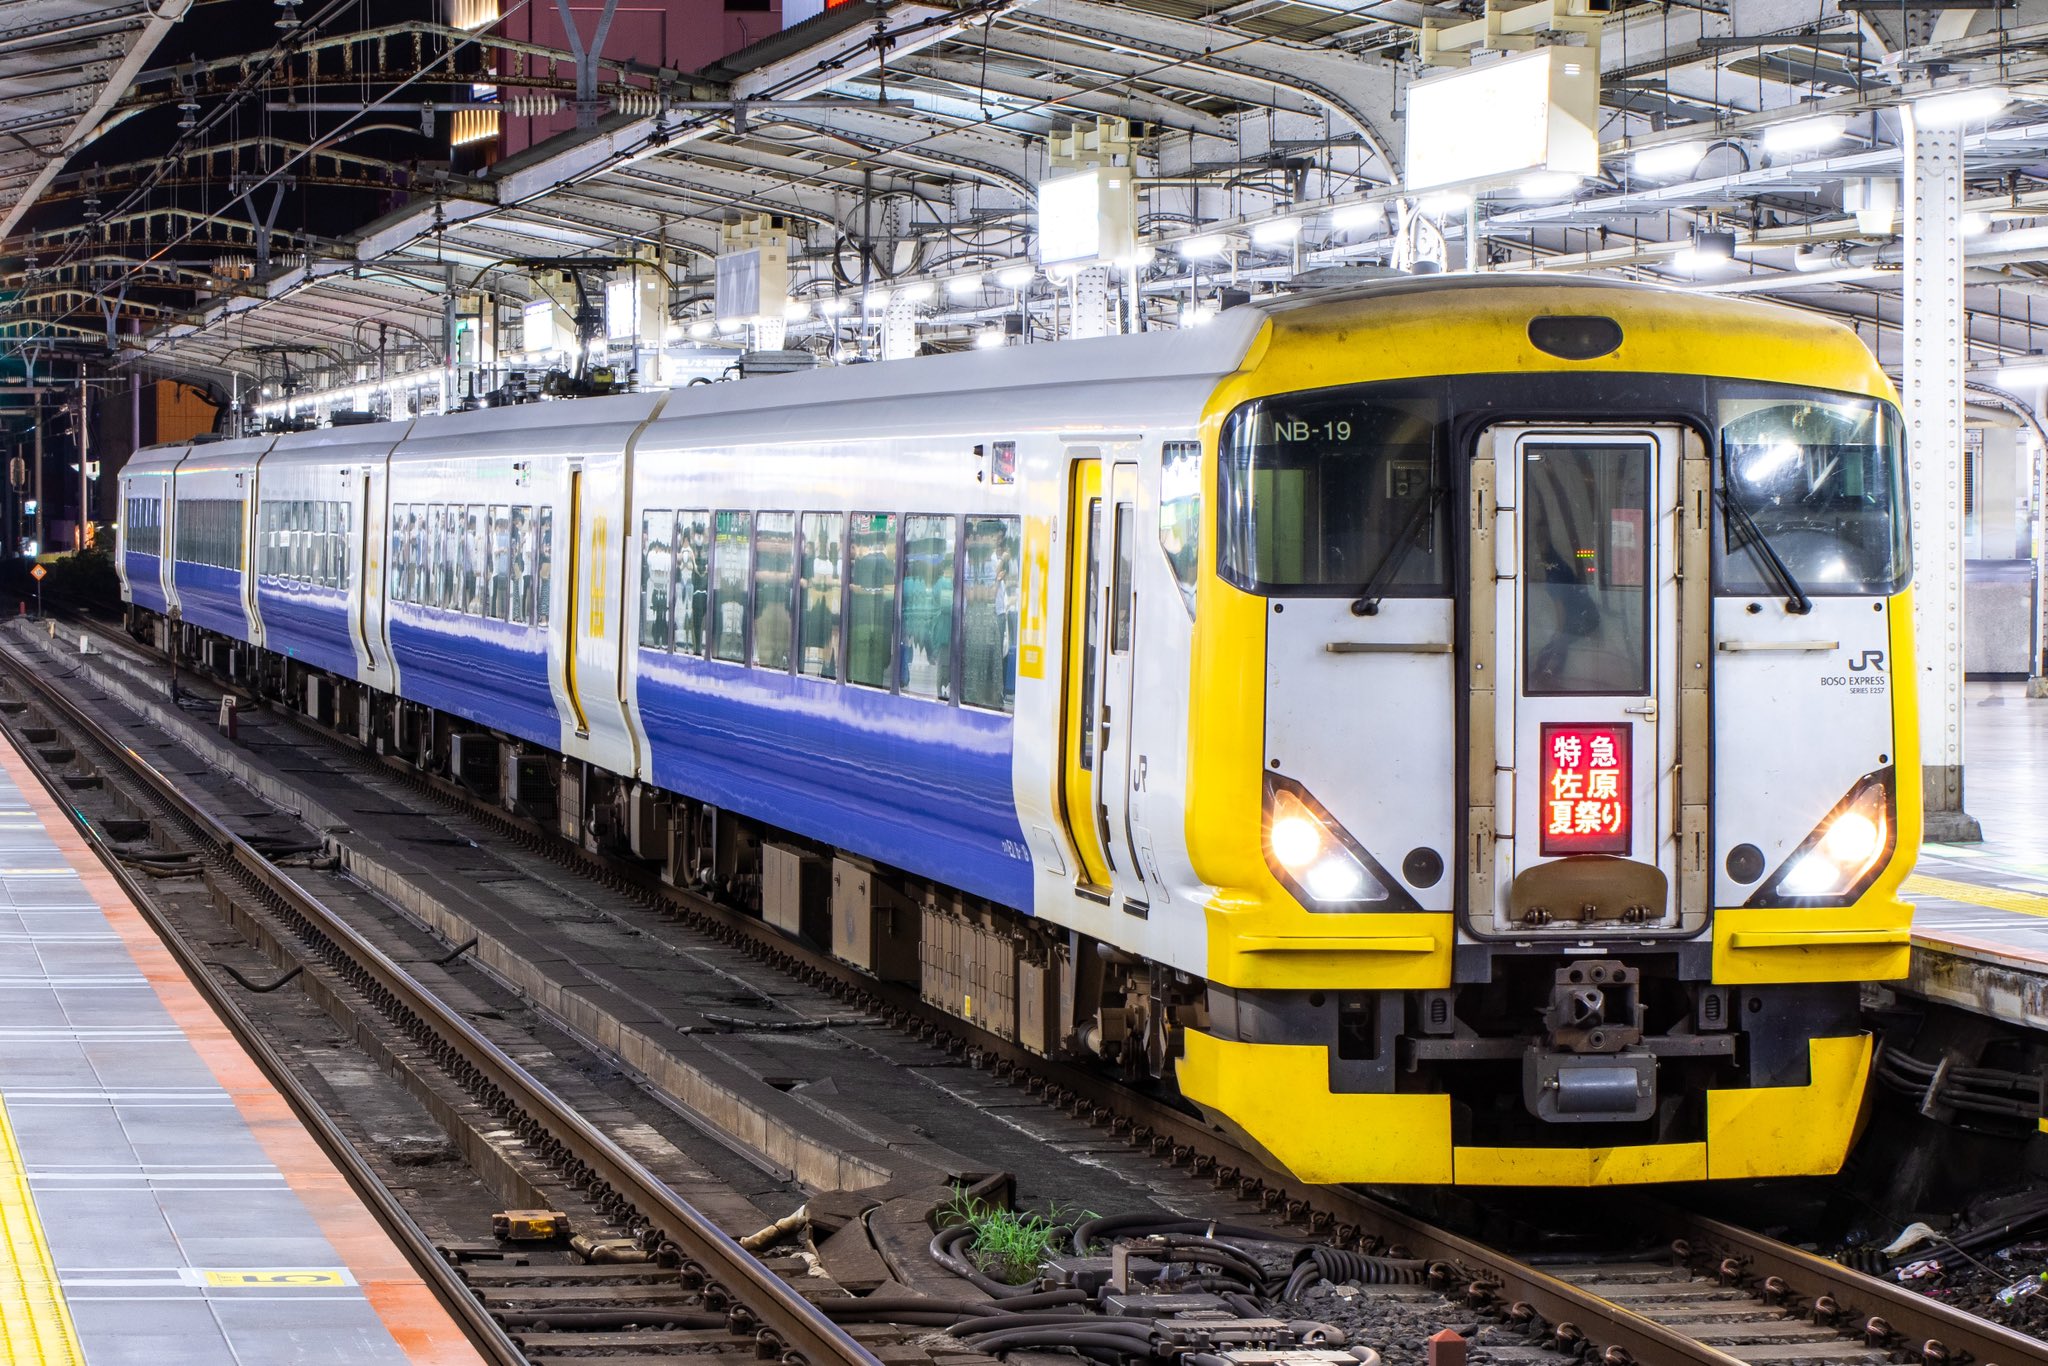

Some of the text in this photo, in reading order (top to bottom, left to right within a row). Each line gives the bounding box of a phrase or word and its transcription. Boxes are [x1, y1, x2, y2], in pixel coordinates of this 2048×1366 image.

[1274, 421, 1351, 442] NB-19
[1848, 650, 1883, 671] JR
[1820, 676, 1885, 686] BOSO EXPRESS
[1554, 735, 1617, 767] 特急
[1133, 754, 1147, 792] JR
[1550, 768, 1620, 799] 佐原
[1548, 800, 1622, 835] 夏祭り
